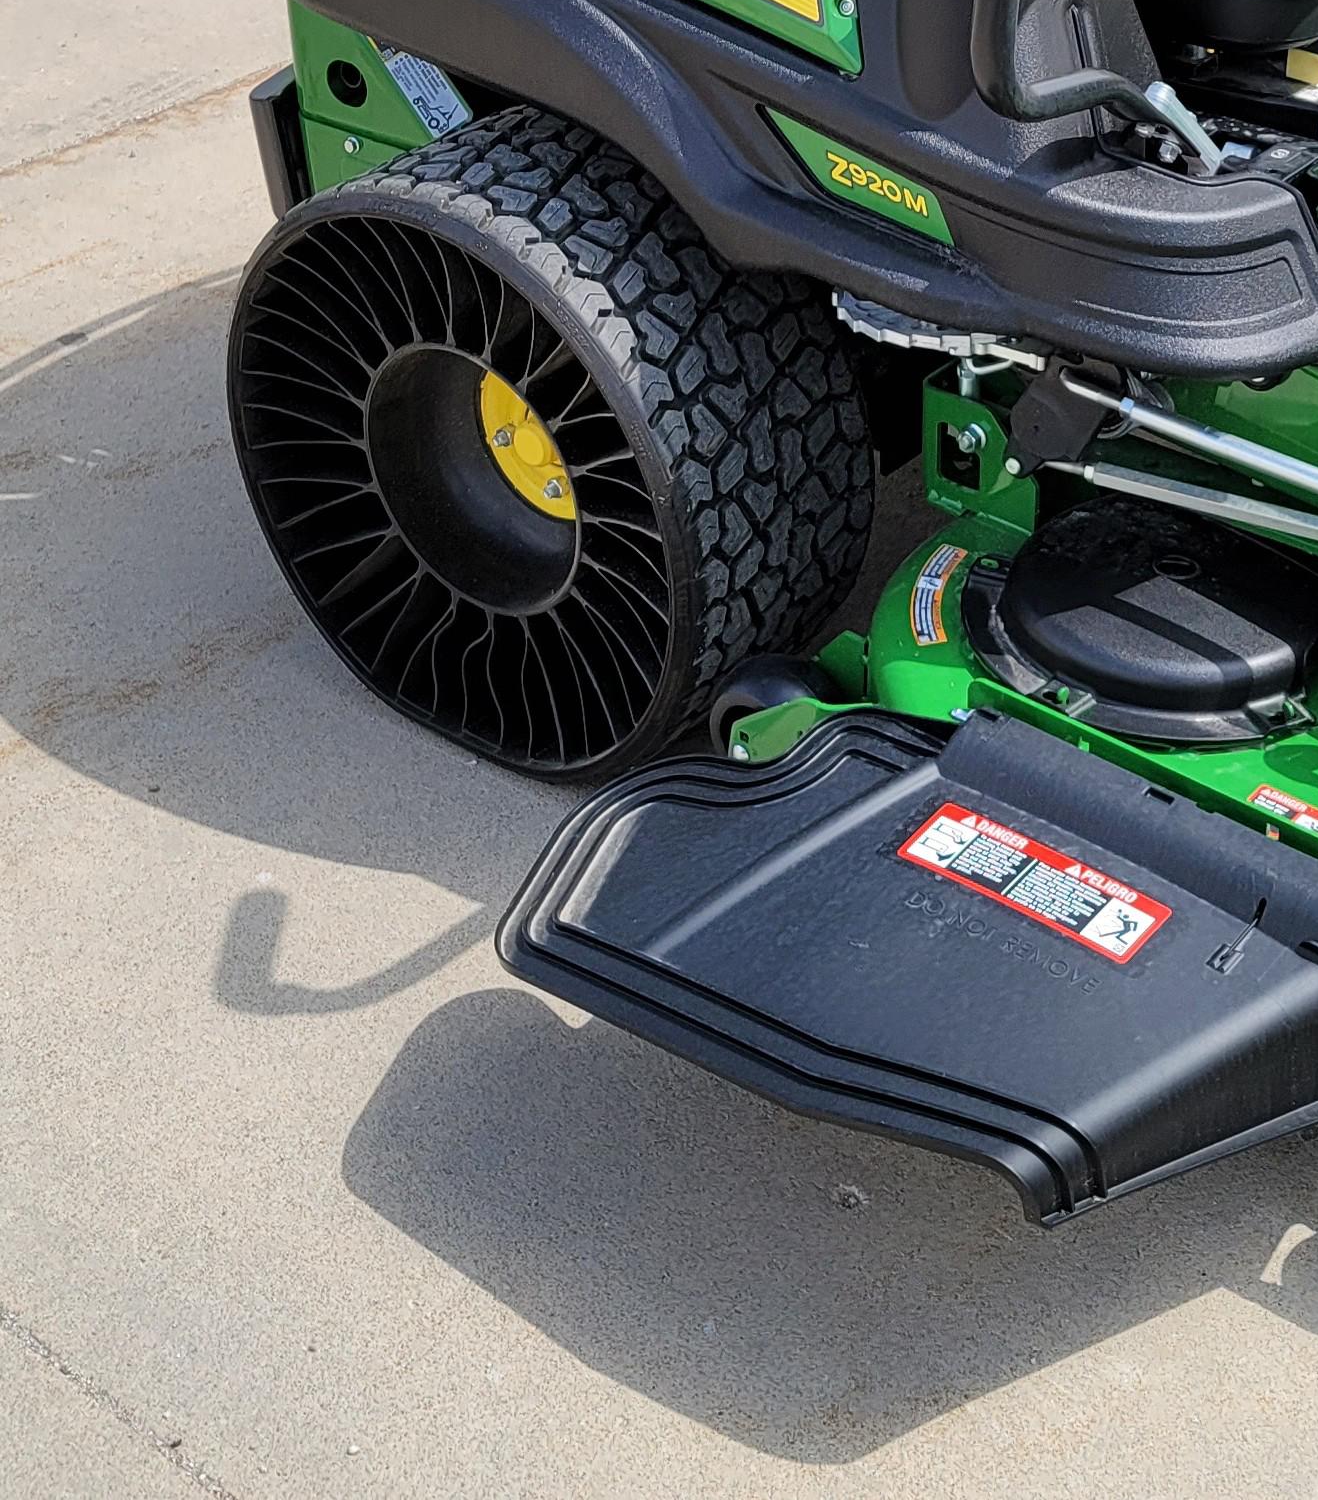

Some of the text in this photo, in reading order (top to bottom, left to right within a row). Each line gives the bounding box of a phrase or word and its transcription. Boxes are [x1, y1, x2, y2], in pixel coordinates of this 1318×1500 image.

[827, 151, 929, 217] Z920M
[1271, 790, 1308, 813] DANGER
[976, 818, 1029, 850] DANGER
[1081, 869, 1138, 903] PELIGRO
[905, 891, 1101, 996] DO NOT REMOVE
